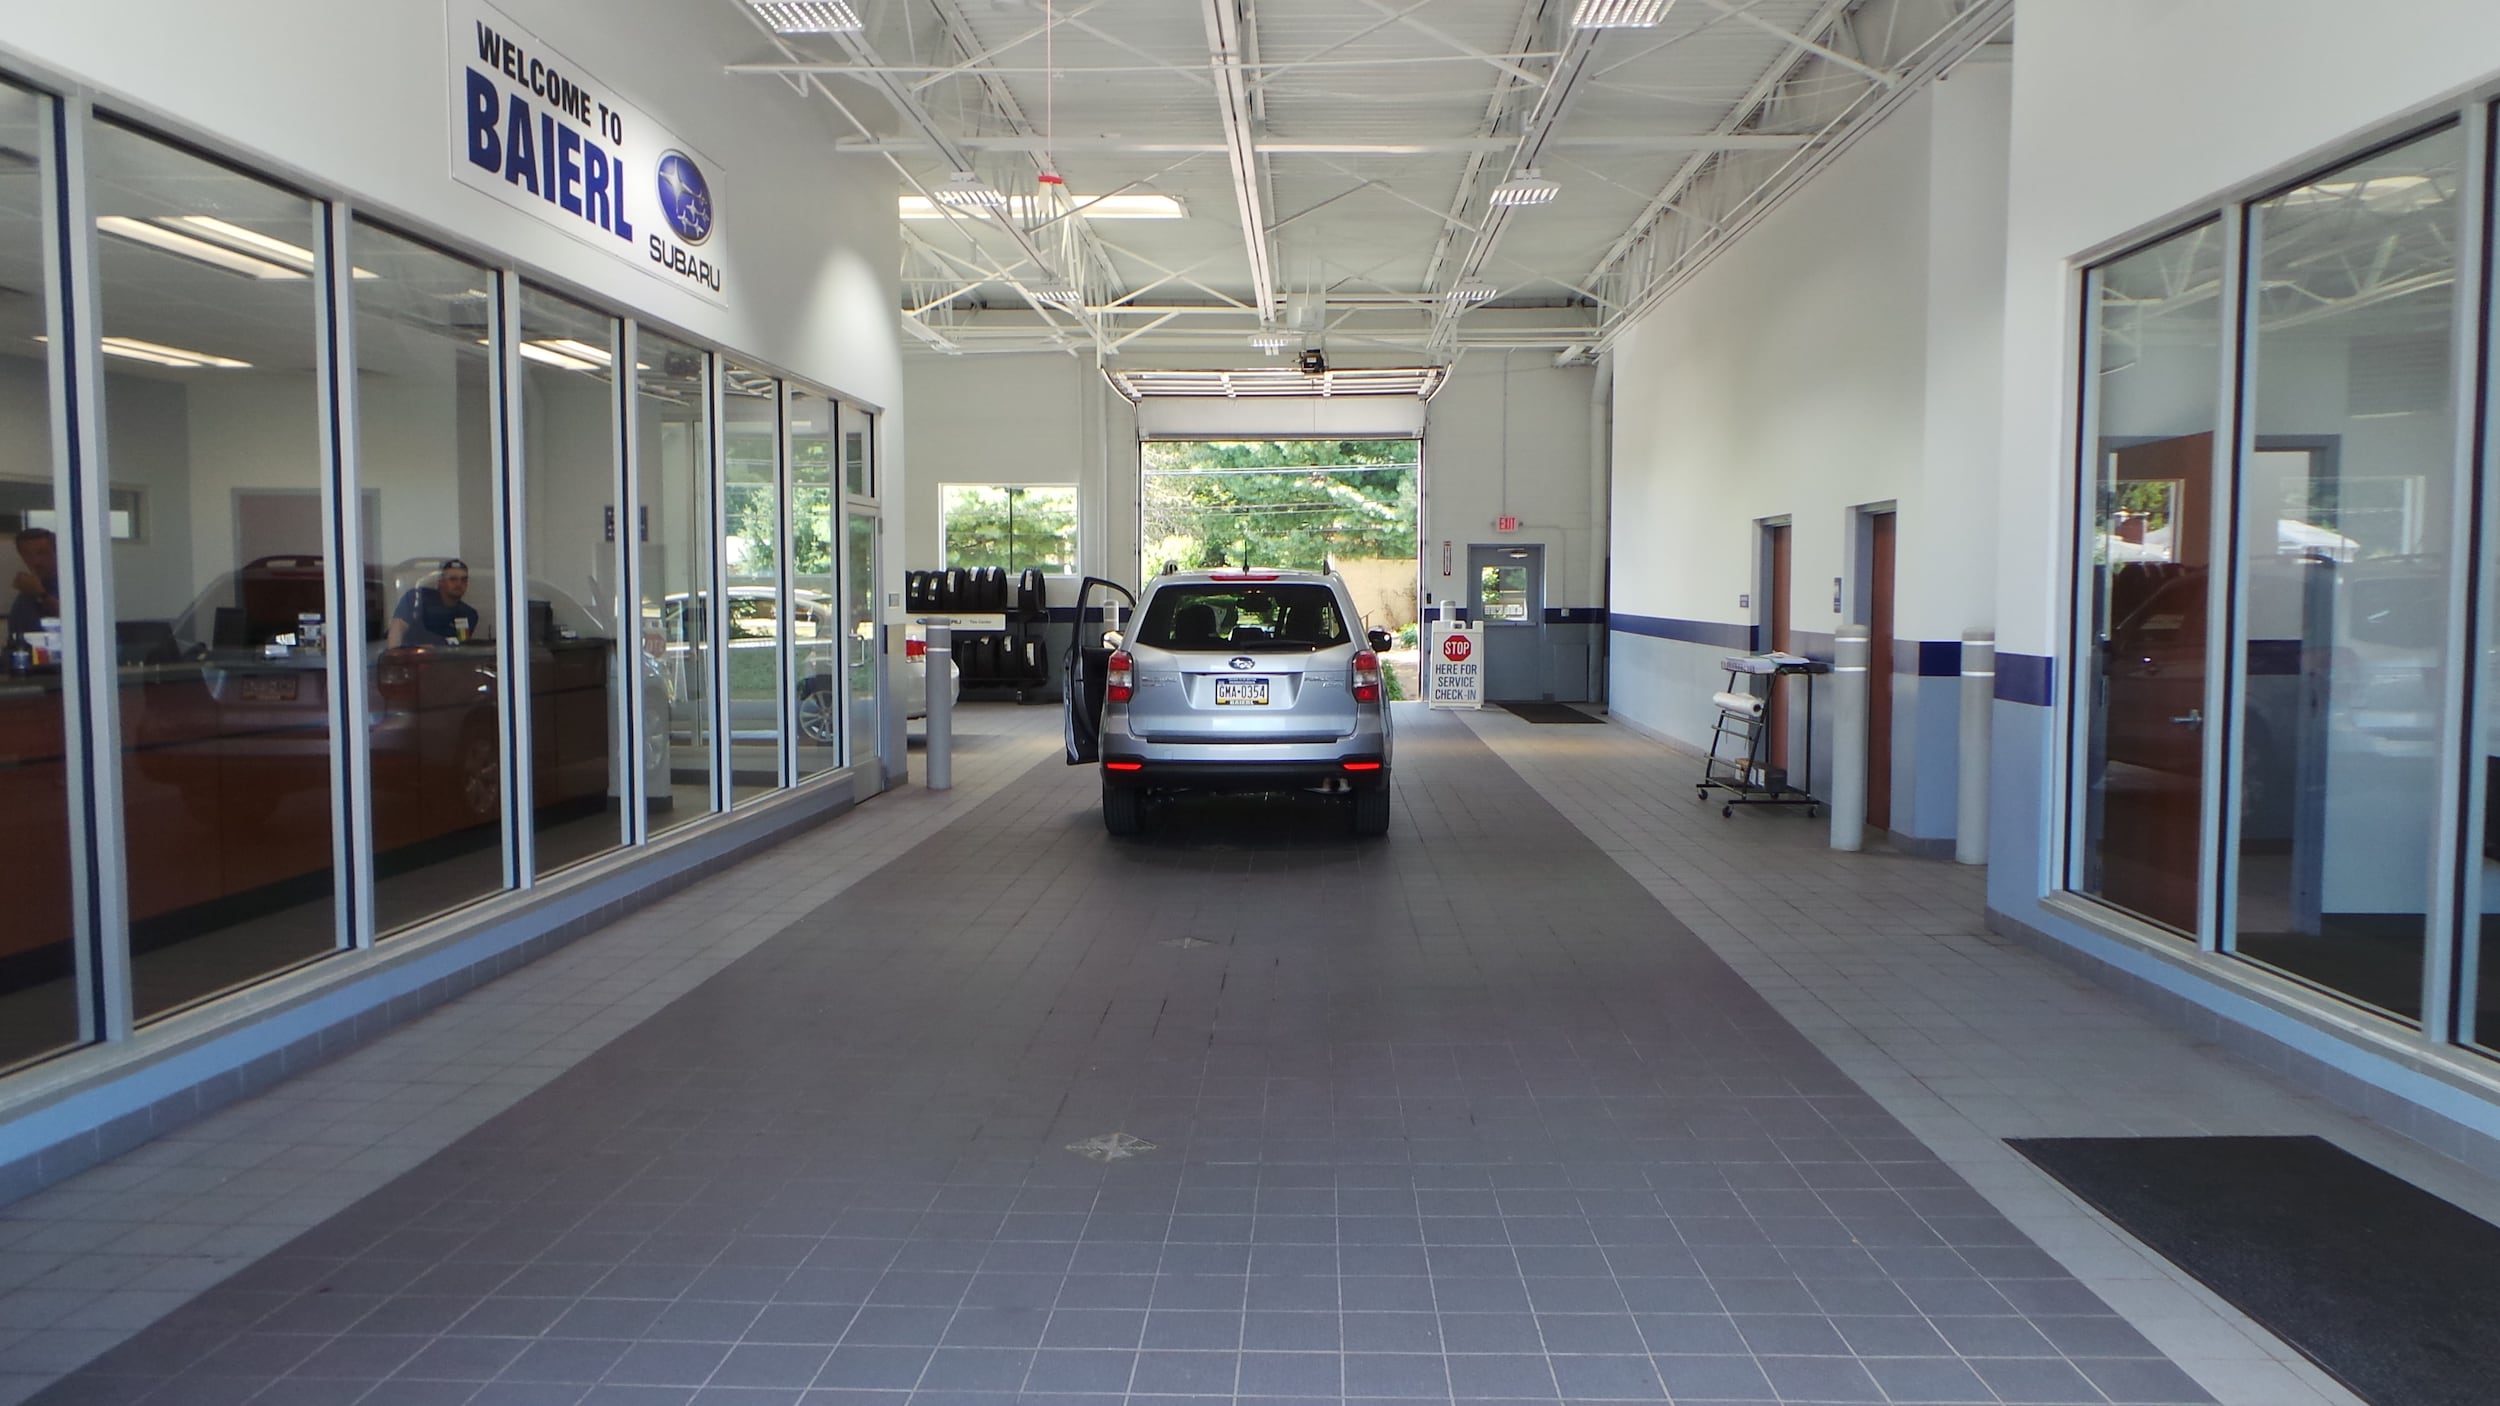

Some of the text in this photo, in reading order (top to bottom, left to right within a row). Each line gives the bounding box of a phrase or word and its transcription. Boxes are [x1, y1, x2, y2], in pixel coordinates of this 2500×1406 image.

[476, 20, 623, 146] WELCOME TO
[466, 66, 633, 243] BAIERL
[649, 235, 721, 292] SUBARU
[1499, 517, 1516, 530] EXIT
[1445, 641, 1470, 655] STOP
[1435, 663, 1477, 675] HERE FOR
[1438, 676, 1475, 688] SERVICE
[1435, 688, 1477, 700] CHECK-IN
